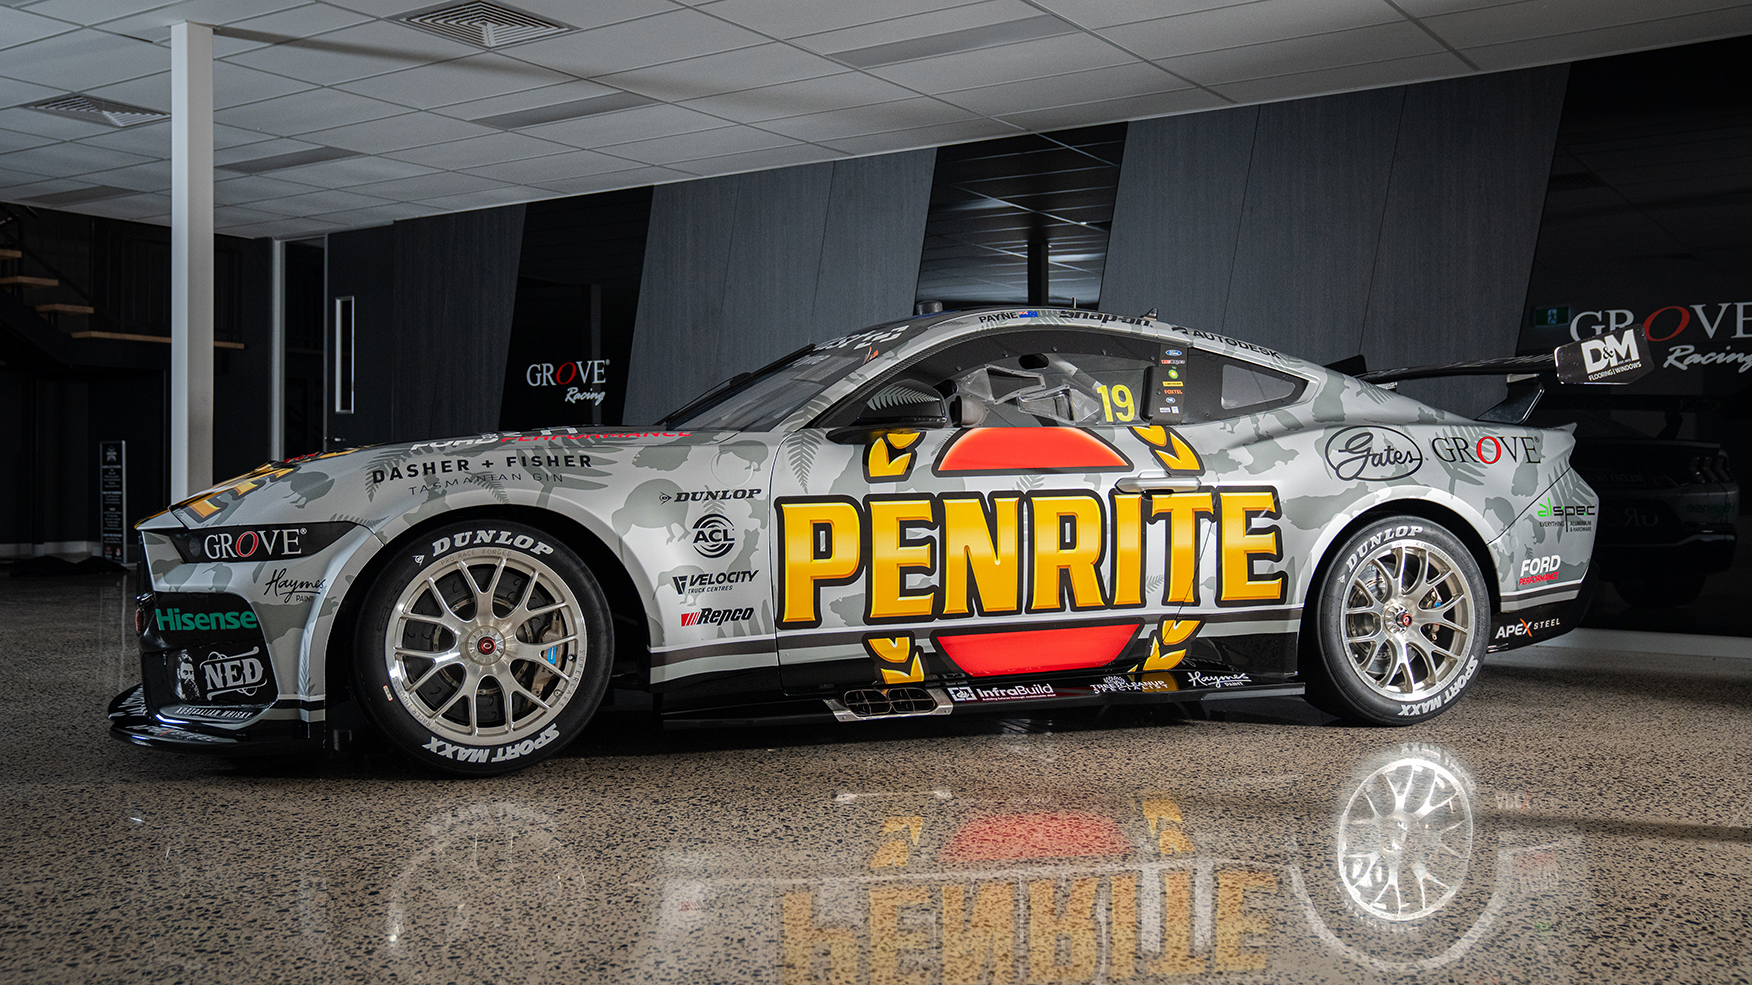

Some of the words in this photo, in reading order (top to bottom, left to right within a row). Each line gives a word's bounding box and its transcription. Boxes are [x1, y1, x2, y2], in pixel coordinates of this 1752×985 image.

[978, 312, 1018, 323] PAYNE
[1193, 330, 1280, 359] AUTODESK
[1581, 329, 1640, 374] D&M
[526, 360, 606, 387] GROVE
[564, 387, 606, 406] Racing
[1097, 384, 1135, 422] 19
[1335, 432, 1421, 480] Gates
[372, 459, 470, 484] DASHER
[506, 454, 593, 468] FISHER
[409, 473, 522, 496] TASMANIAN
[532, 473, 563, 483] GIN
[673, 488, 762, 502] DUNLOP
[432, 530, 554, 557] DUNLOP
[693, 529, 735, 543] ACL
[776, 487, 1286, 629] PENRITE
[1346, 526, 1423, 572] DUNLOP
[1520, 554, 1561, 577] FORD
[264, 568, 326, 603] Haymes
[689, 570, 759, 587] VELOCITY
[1518, 571, 1559, 586] PERFORMANCE
[155, 608, 257, 631] Hisense
[696, 607, 755, 626] Repco
[1495, 618, 1533, 639] APEX
[1534, 617, 1561, 630] STEEL
[203, 656, 265, 691] NED
[1187, 671, 1252, 688] Haymes
[1443, 655, 1478, 704] SPORT
[976, 684, 1055, 698] InfraBuild
[174, 706, 222, 717] AUSTRALIAN
[1398, 695, 1442, 716] MAXX
[422, 736, 491, 763] MAXX
[491, 722, 560, 763] SPORT
